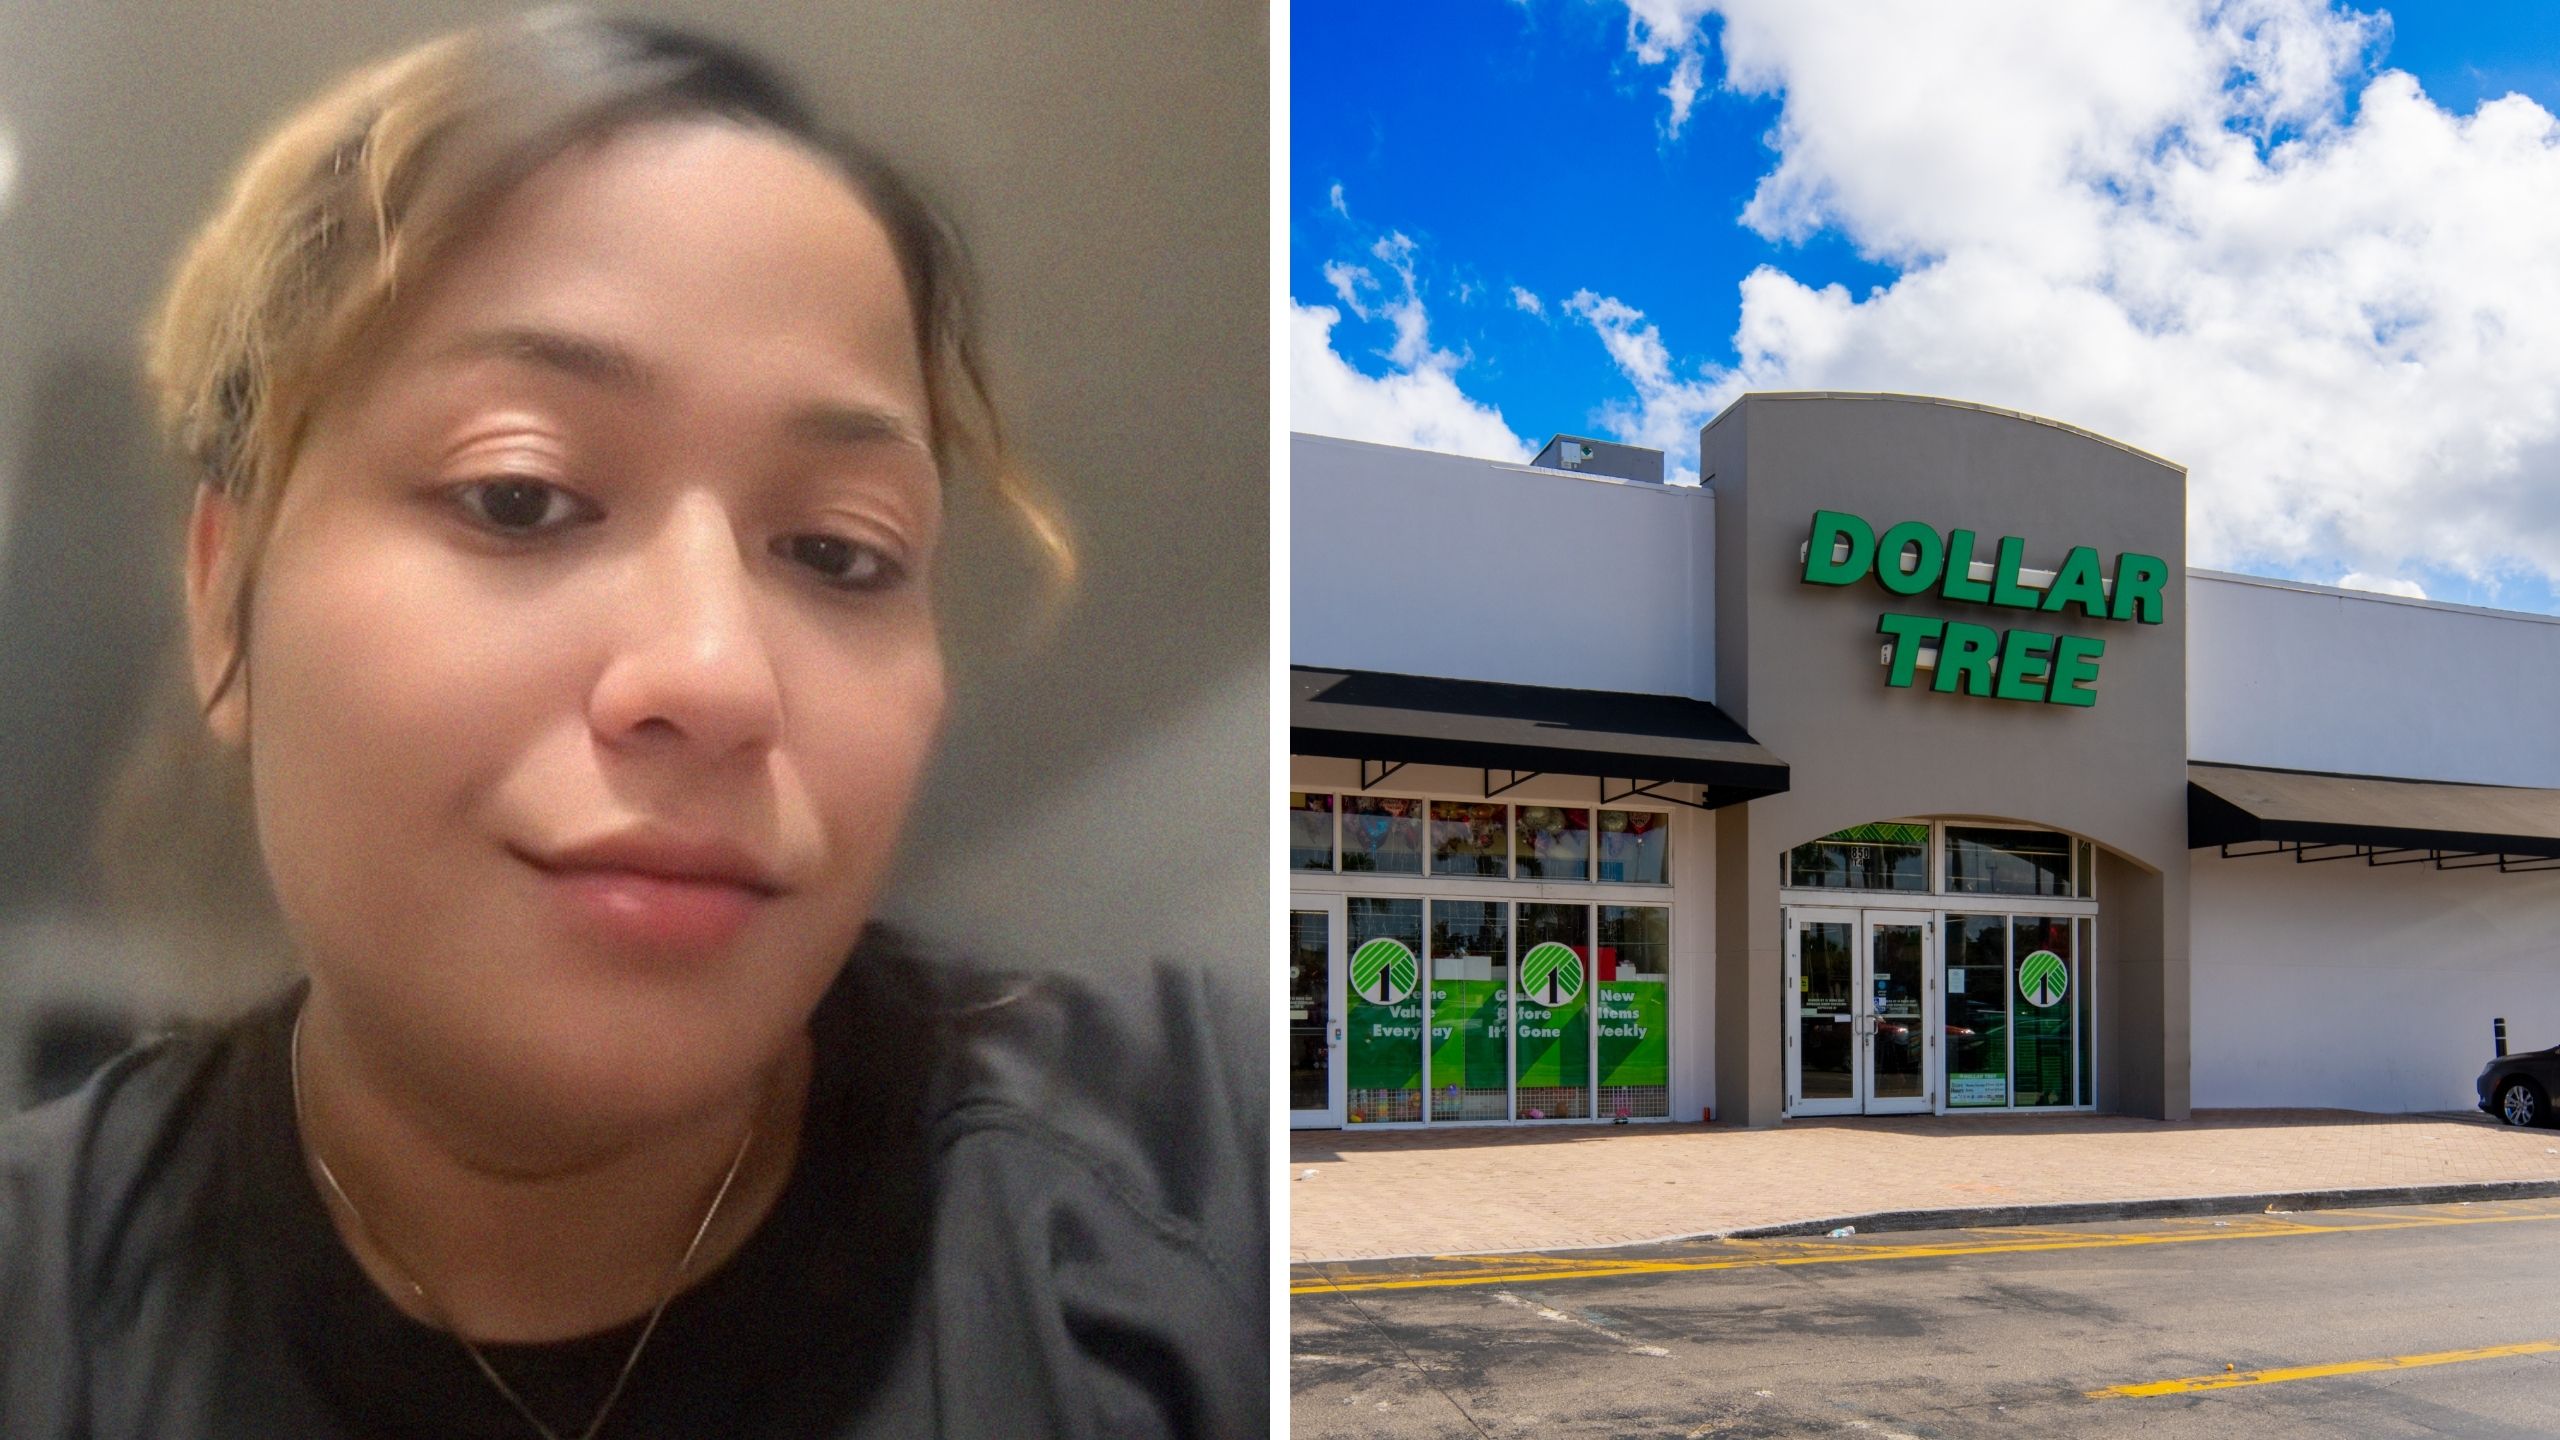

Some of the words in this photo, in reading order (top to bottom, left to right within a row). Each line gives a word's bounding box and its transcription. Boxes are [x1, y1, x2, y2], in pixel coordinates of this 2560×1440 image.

[1801, 510, 2169, 625] DOLLAR
[1876, 612, 2106, 708] TREE
[1600, 989, 1636, 1002] New
[1497, 1006, 1552, 1020] Bfore
[1598, 1007, 1641, 1020] Items
[1372, 1023, 1453, 1040] Everyay
[1488, 1025, 1508, 1038] It'
[1518, 1025, 1561, 1038] Gone
